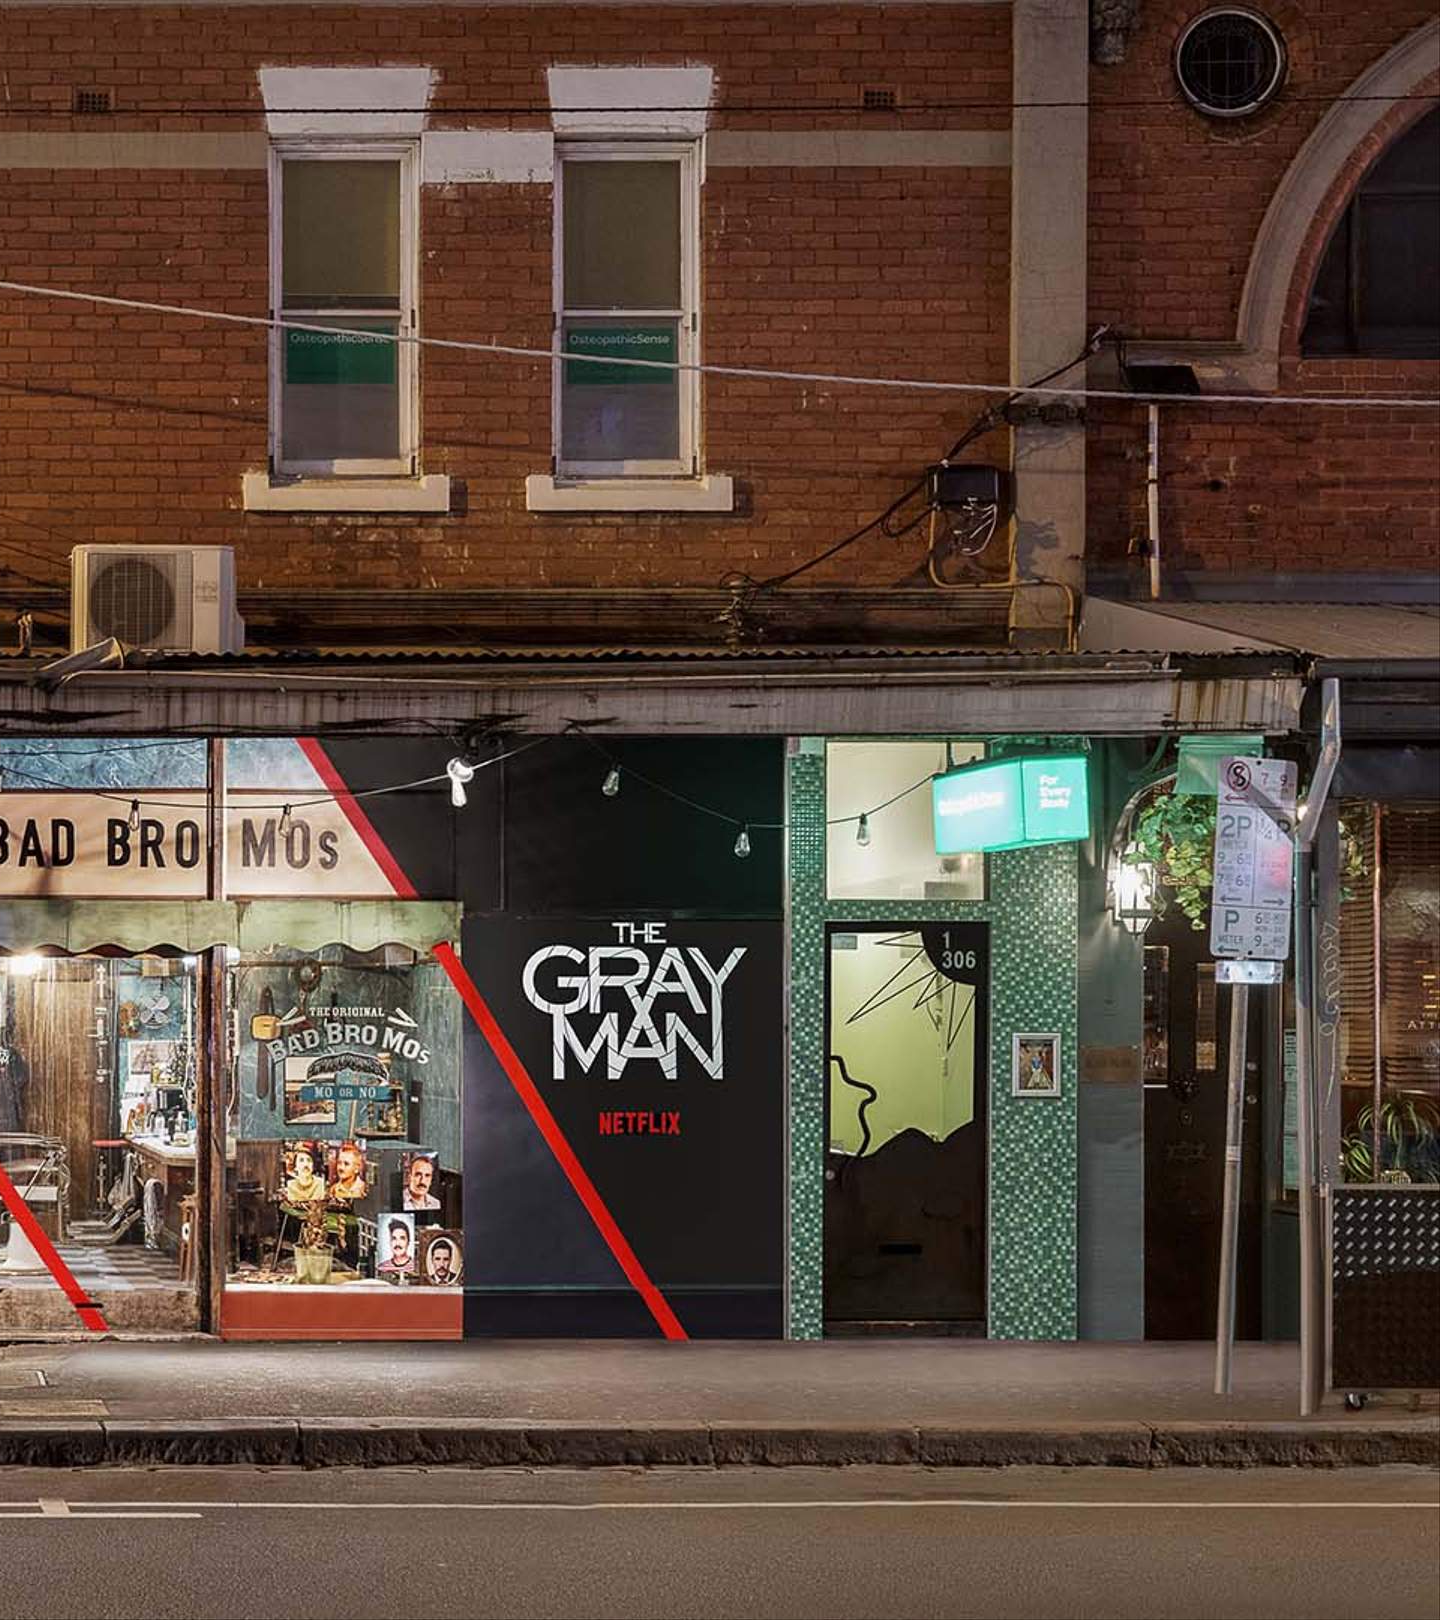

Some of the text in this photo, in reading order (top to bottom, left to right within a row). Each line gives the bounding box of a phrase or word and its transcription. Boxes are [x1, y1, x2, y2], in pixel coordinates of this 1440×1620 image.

[1220, 815, 1252, 839] 2P
[106, 818, 201, 869] BRO
[1224, 909, 1240, 932] P
[611, 922, 667, 944] THE
[942, 931, 951, 949] 1
[941, 950, 977, 970] 306
[522, 945, 748, 1014] GRAY
[309, 1007, 386, 1018] THE ORIGINAL
[265, 1028, 321, 1064] BAD
[326, 1022, 378, 1045] BRO
[553, 1010, 723, 1080] MAN
[314, 1087, 377, 1098] MO OR NO
[599, 1111, 681, 1135] NETFLIX
